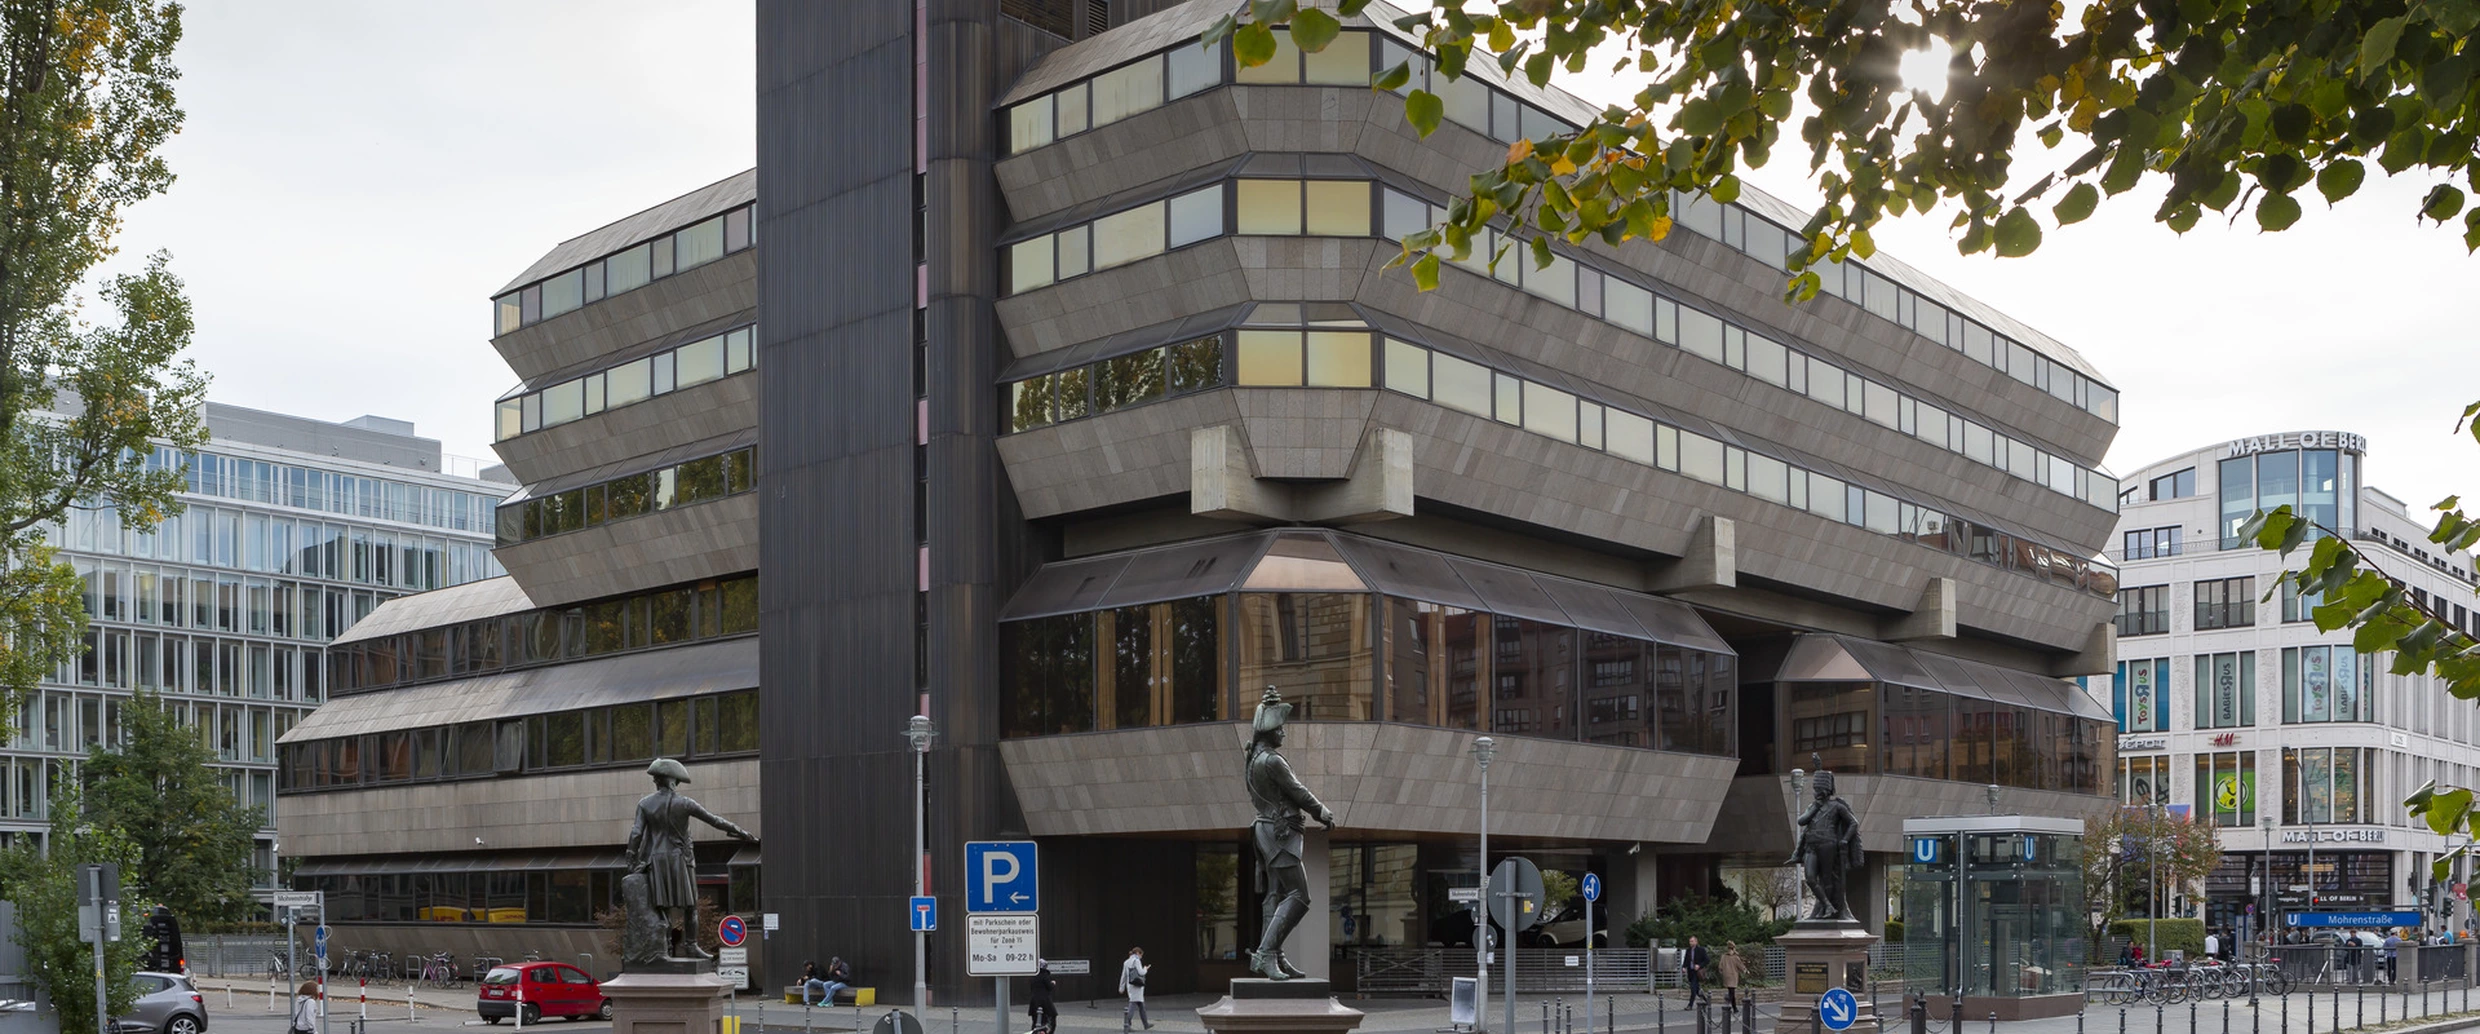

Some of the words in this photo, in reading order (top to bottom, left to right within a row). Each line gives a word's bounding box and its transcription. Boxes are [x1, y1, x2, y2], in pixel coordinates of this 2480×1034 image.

[2228, 432, 2290, 456] MALL
[2299, 431, 2334, 448] OF
[2282, 831, 2326, 843] MAL
[2333, 830, 2354, 842] OF
[1917, 839, 1934, 861] U
[2025, 837, 2034, 860] U
[983, 851, 1020, 903] P
[2287, 913, 2298, 926] U
[2328, 914, 2393, 925] Mohrenstraße
[972, 953, 997, 962] Mo-Sa
[1005, 953, 1027, 962] 09-22
[1029, 953, 1034, 961] h
